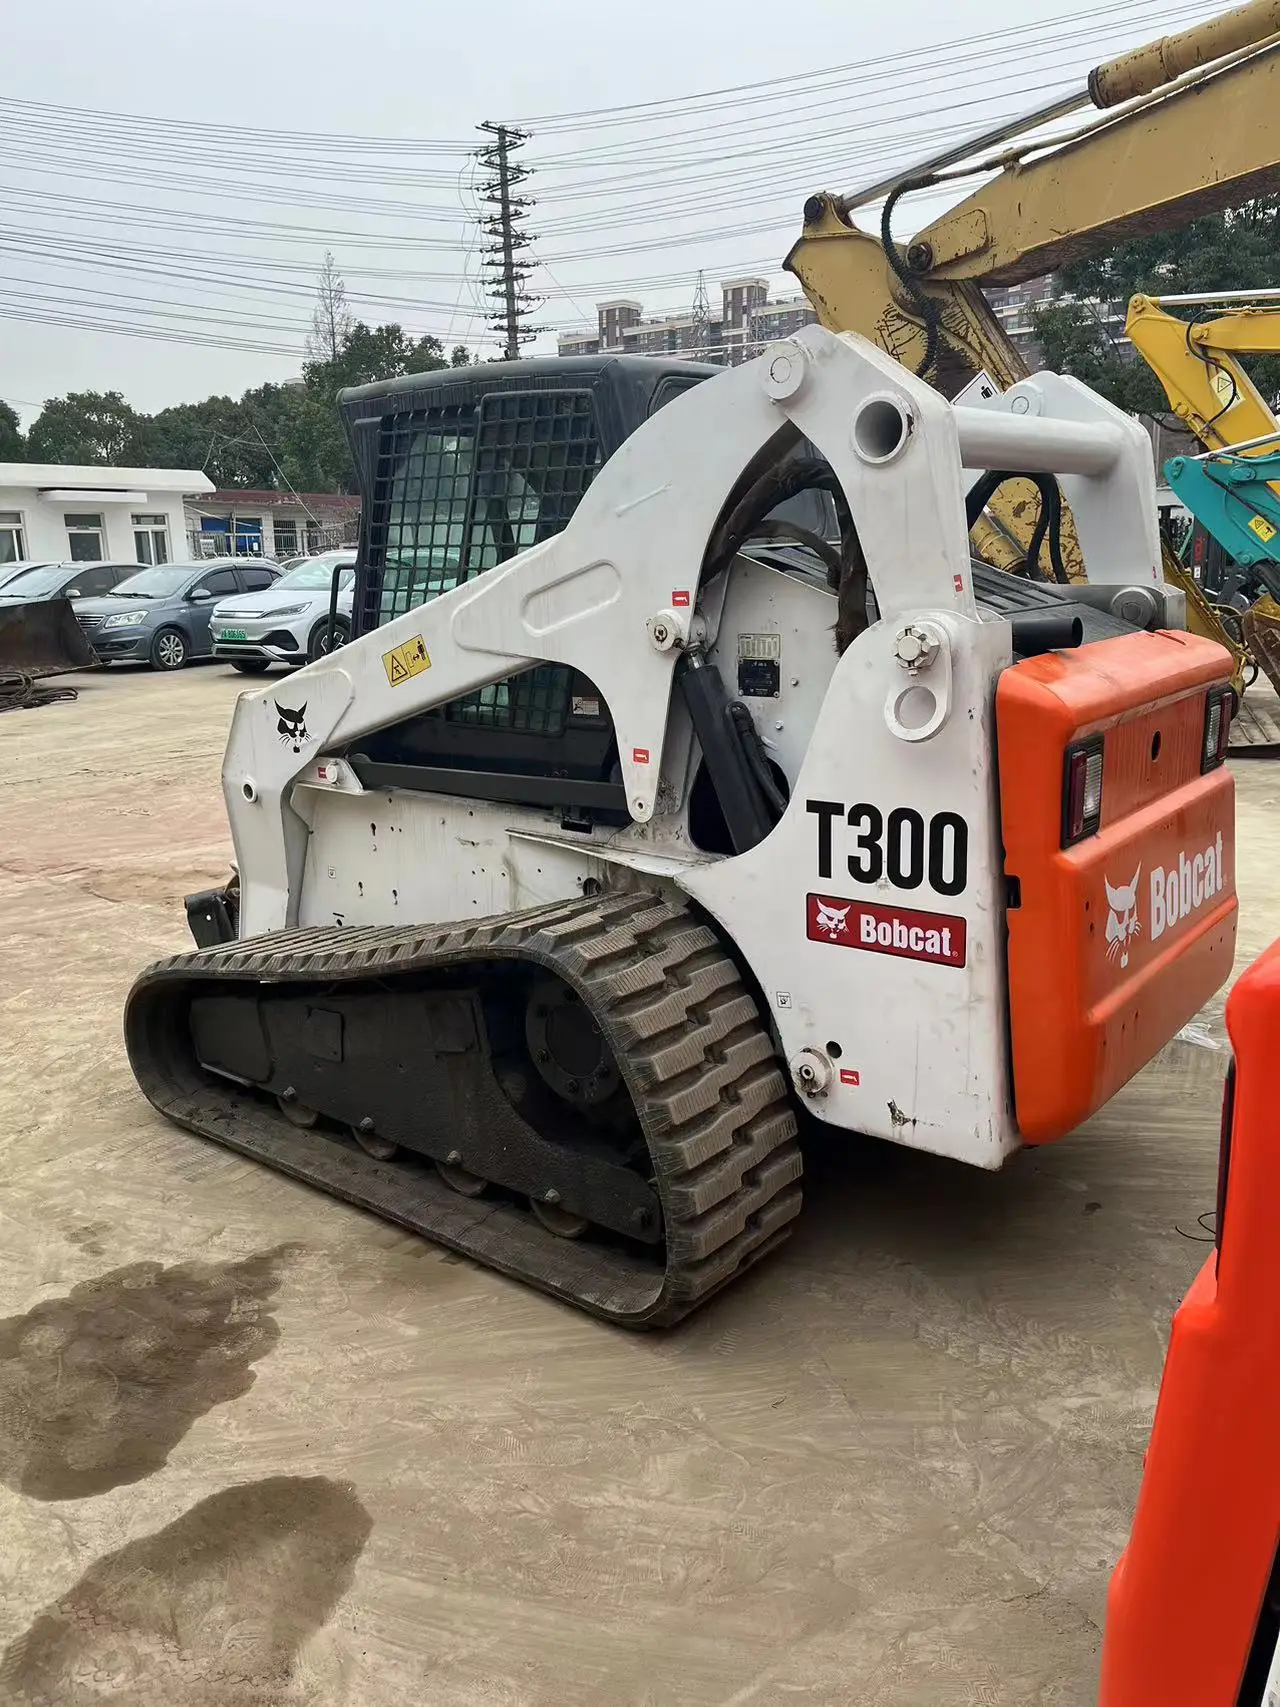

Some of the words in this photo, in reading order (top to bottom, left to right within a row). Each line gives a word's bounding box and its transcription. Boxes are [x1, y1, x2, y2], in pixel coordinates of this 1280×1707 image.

[806, 799, 968, 897] T300
[1151, 830, 1223, 941] Bobcat
[860, 913, 951, 957] Bobcat
